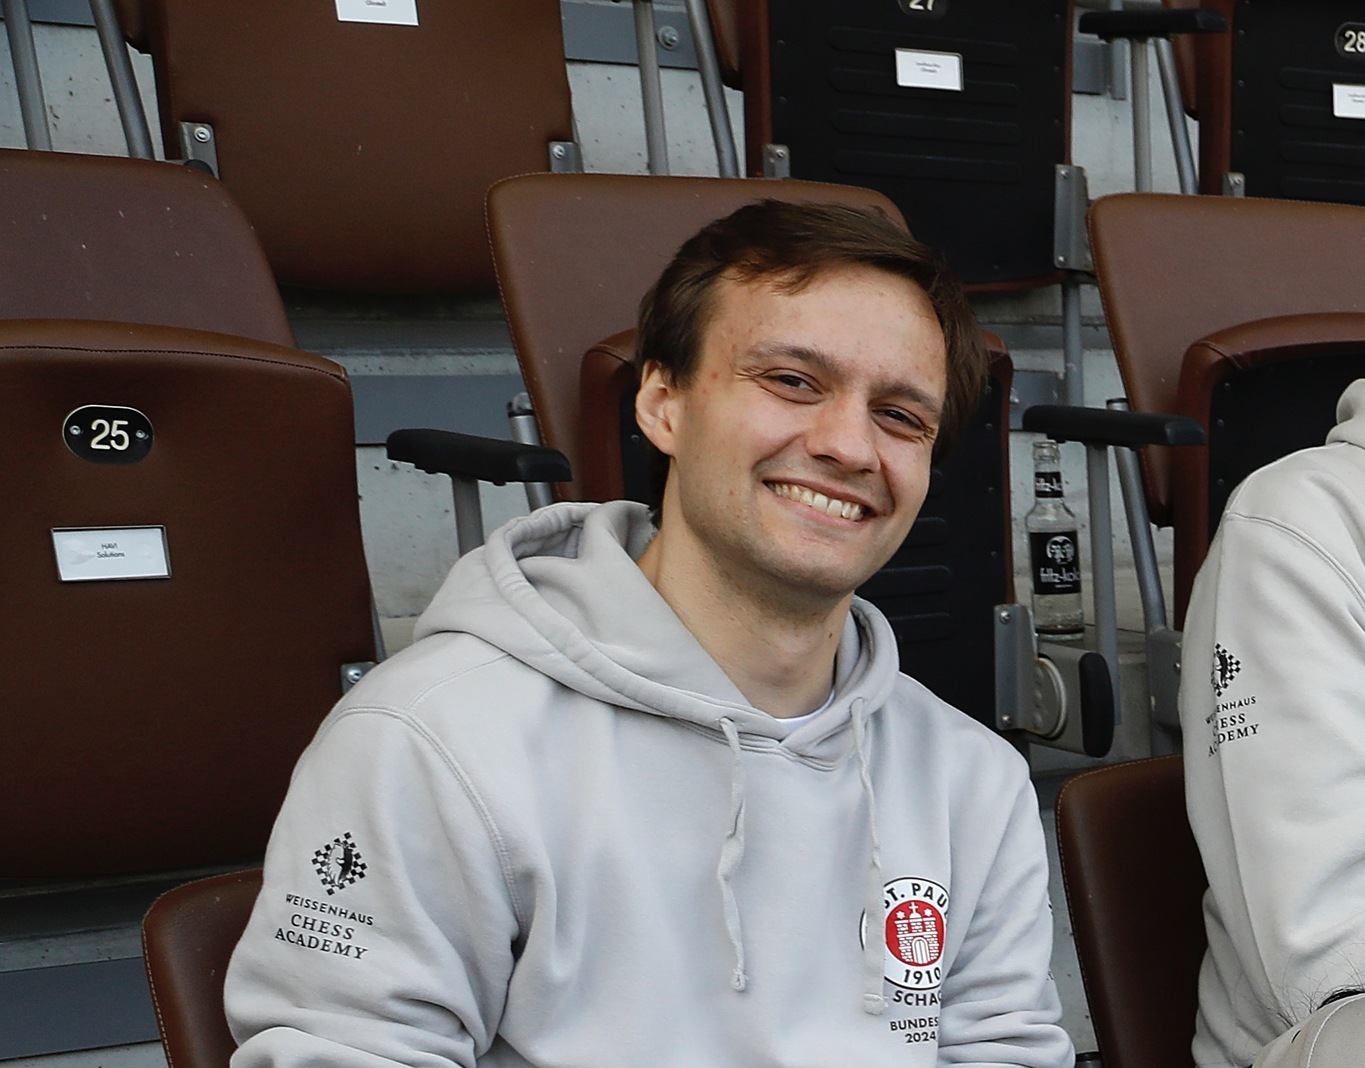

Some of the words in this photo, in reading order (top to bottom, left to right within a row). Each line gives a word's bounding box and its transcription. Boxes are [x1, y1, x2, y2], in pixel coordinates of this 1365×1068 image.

[90, 419, 130, 451] 25
[97, 551, 125, 559] Solutions
[911, 882, 948, 909] PAU
[285, 893, 374, 926] WEISSENHAUS
[291, 914, 355, 940] CHESS
[275, 928, 369, 960] ACADEMY
[904, 966, 941, 984] 1910
[893, 990, 941, 1007] SCHA
[890, 1016, 939, 1032] BUNDES
[905, 1031, 936, 1043] 2024
